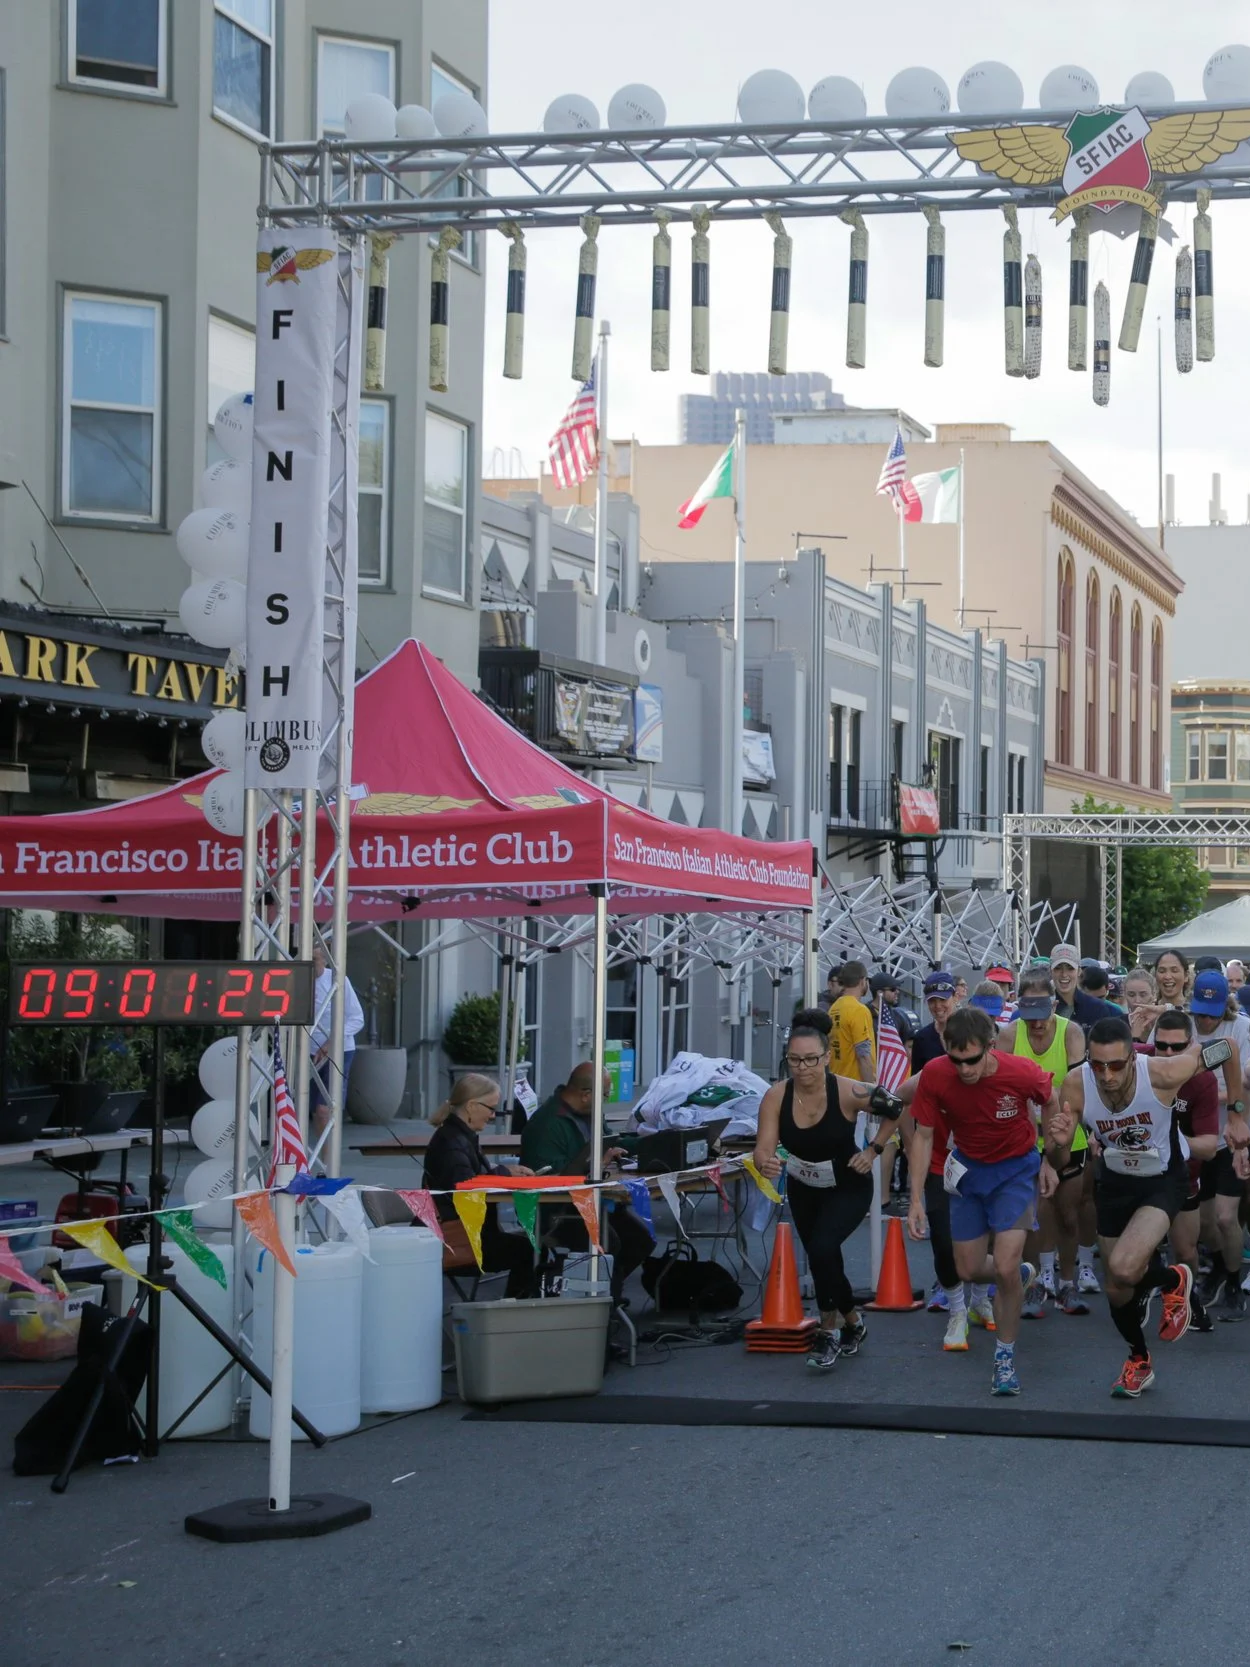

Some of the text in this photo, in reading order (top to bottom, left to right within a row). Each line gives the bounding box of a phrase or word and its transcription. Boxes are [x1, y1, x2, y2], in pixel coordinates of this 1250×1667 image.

[1075, 123, 1134, 175] SFIAC
[1064, 192, 1149, 209] FOUNDATION
[128, 653, 247, 709] TAVE
[245, 720, 321, 741] LUMBU
[14, 841, 188, 874] Francisco
[486, 831, 574, 865] Club
[613, 834, 810, 890] San Francisco Italian Athletic Club Foundation
[18, 968, 292, 1018] 09:01:25
[1096, 1111, 1153, 1133] HALF MOON BAY
[799, 1170, 819, 1180] 474
[1123, 1158, 1139, 1167] 67
